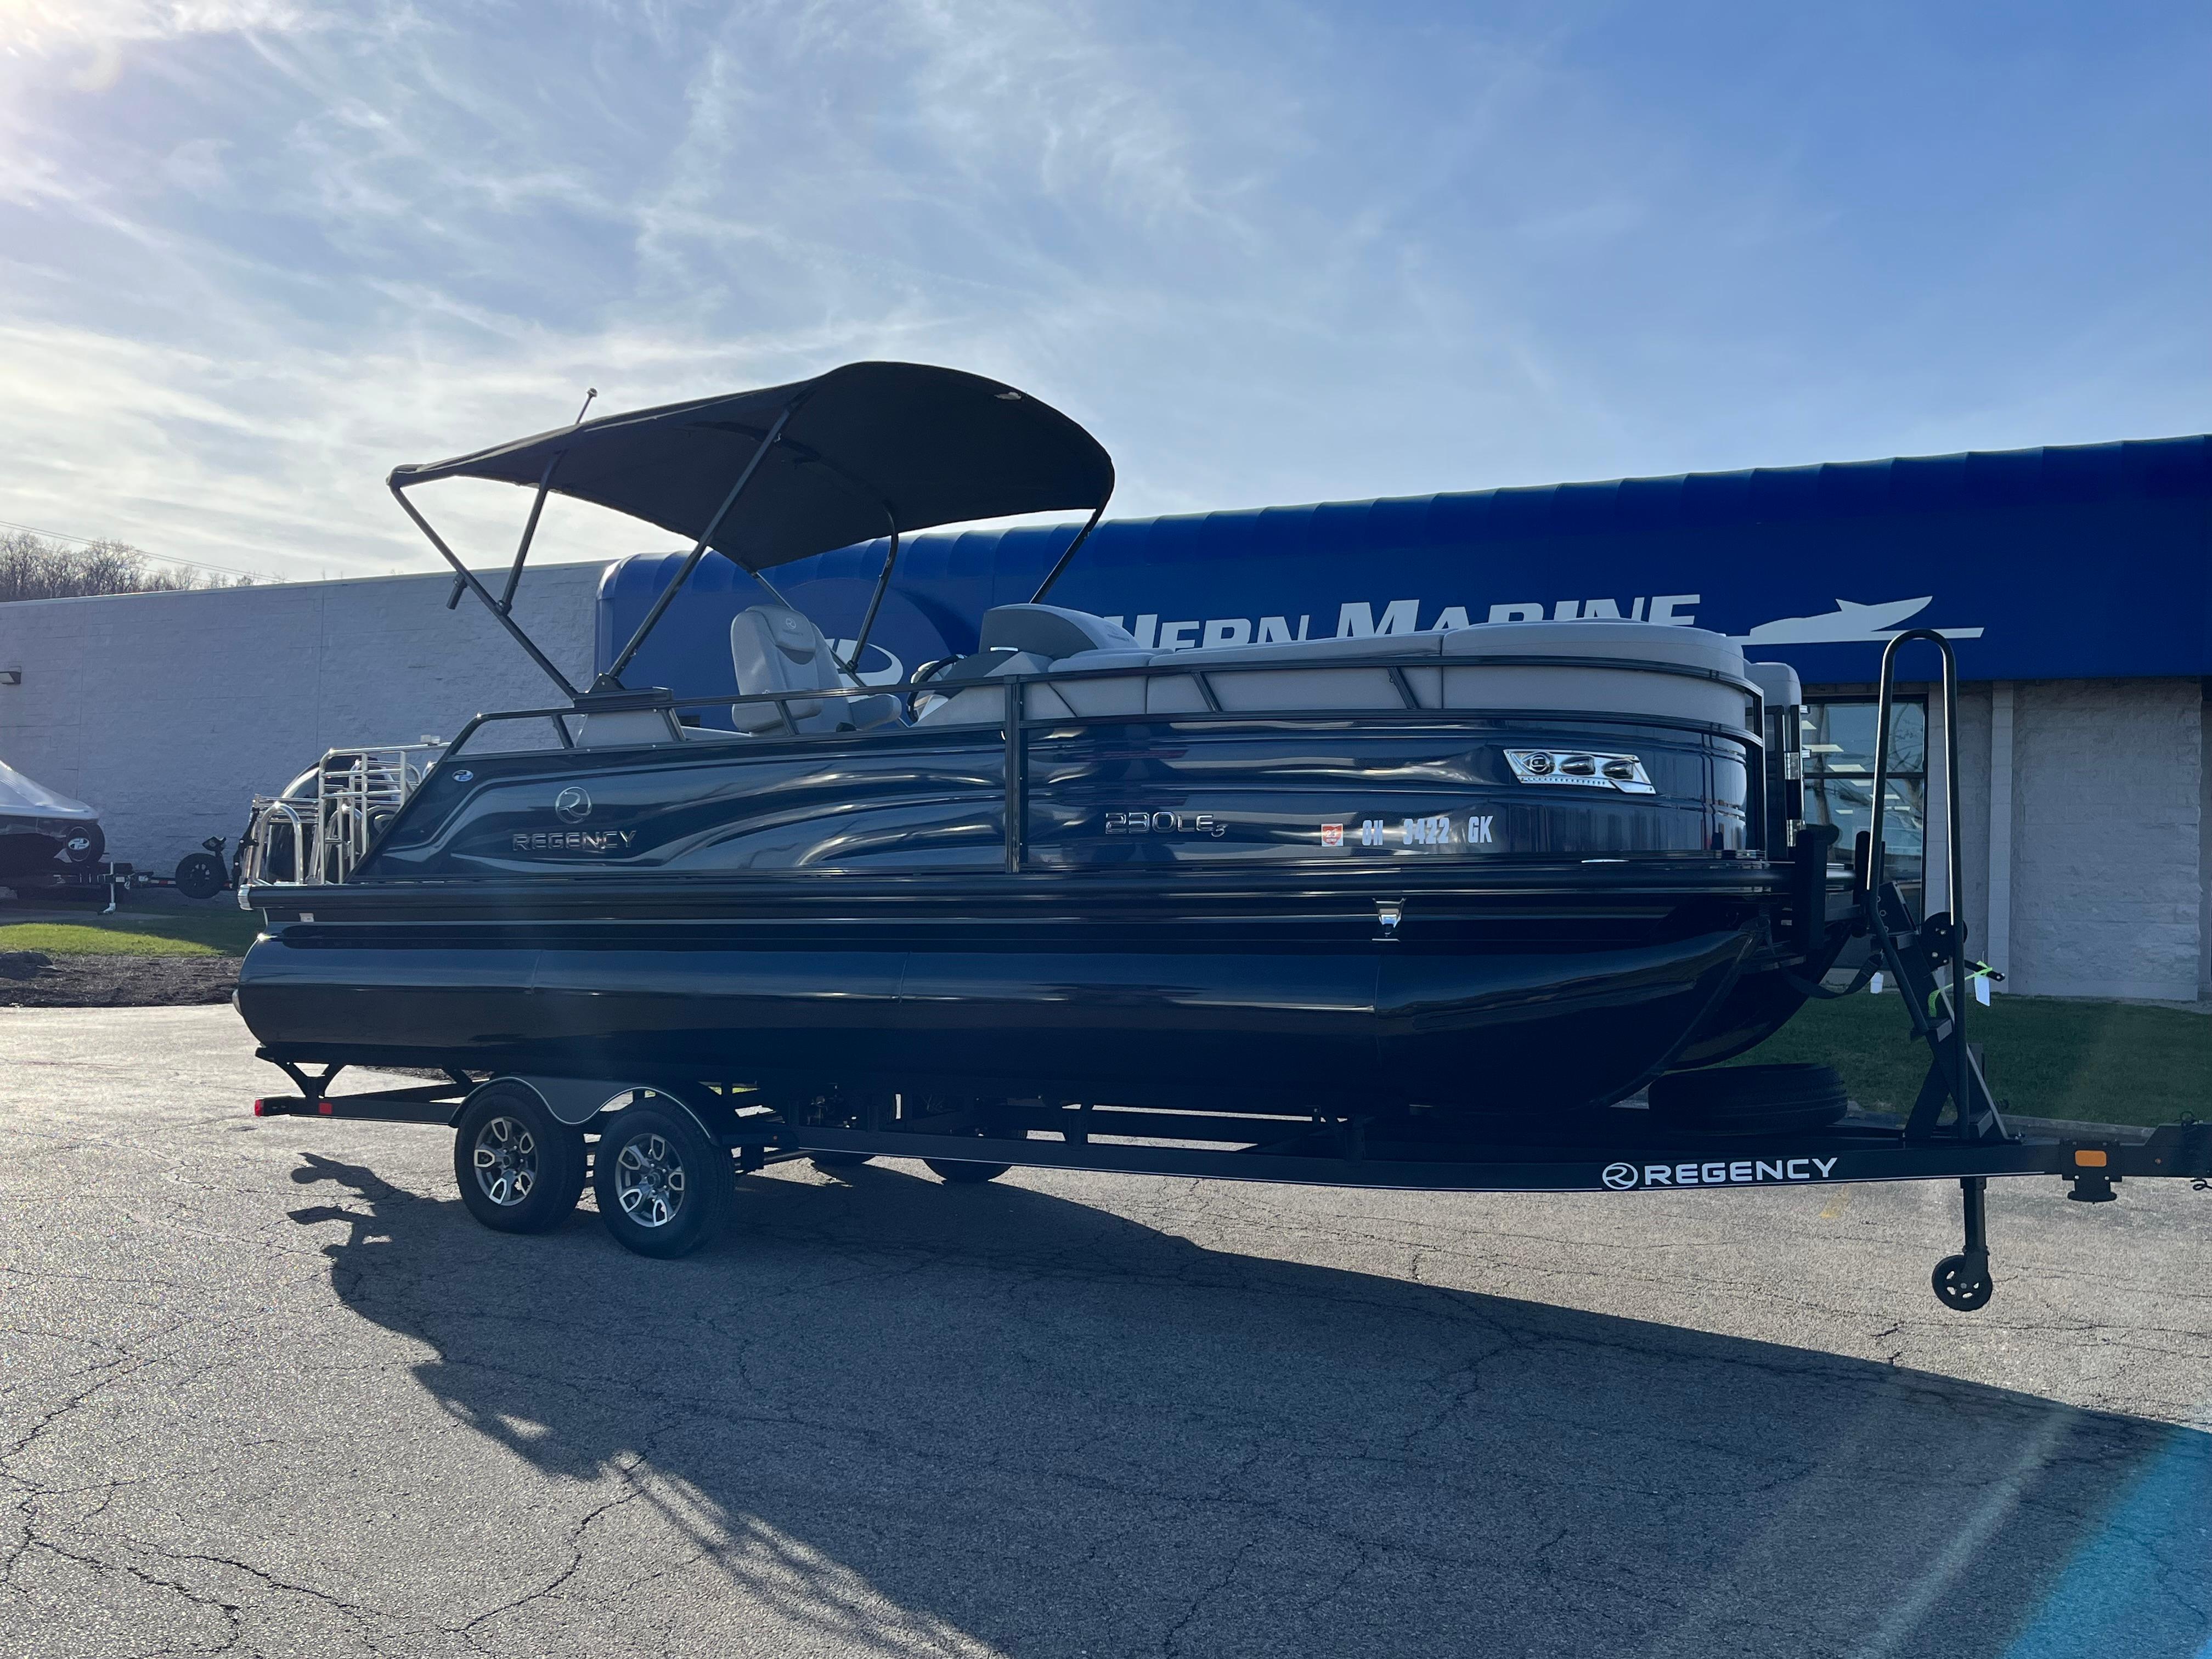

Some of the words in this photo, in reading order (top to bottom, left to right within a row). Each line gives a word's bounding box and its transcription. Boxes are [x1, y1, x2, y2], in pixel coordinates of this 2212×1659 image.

[514, 830, 636, 851] REGENCY
[1362, 820, 1383, 845] OH
[1404, 817, 1449, 845] 3422
[1468, 815, 1493, 843] GK
[1645, 1158, 1838, 1185] REGENCY
